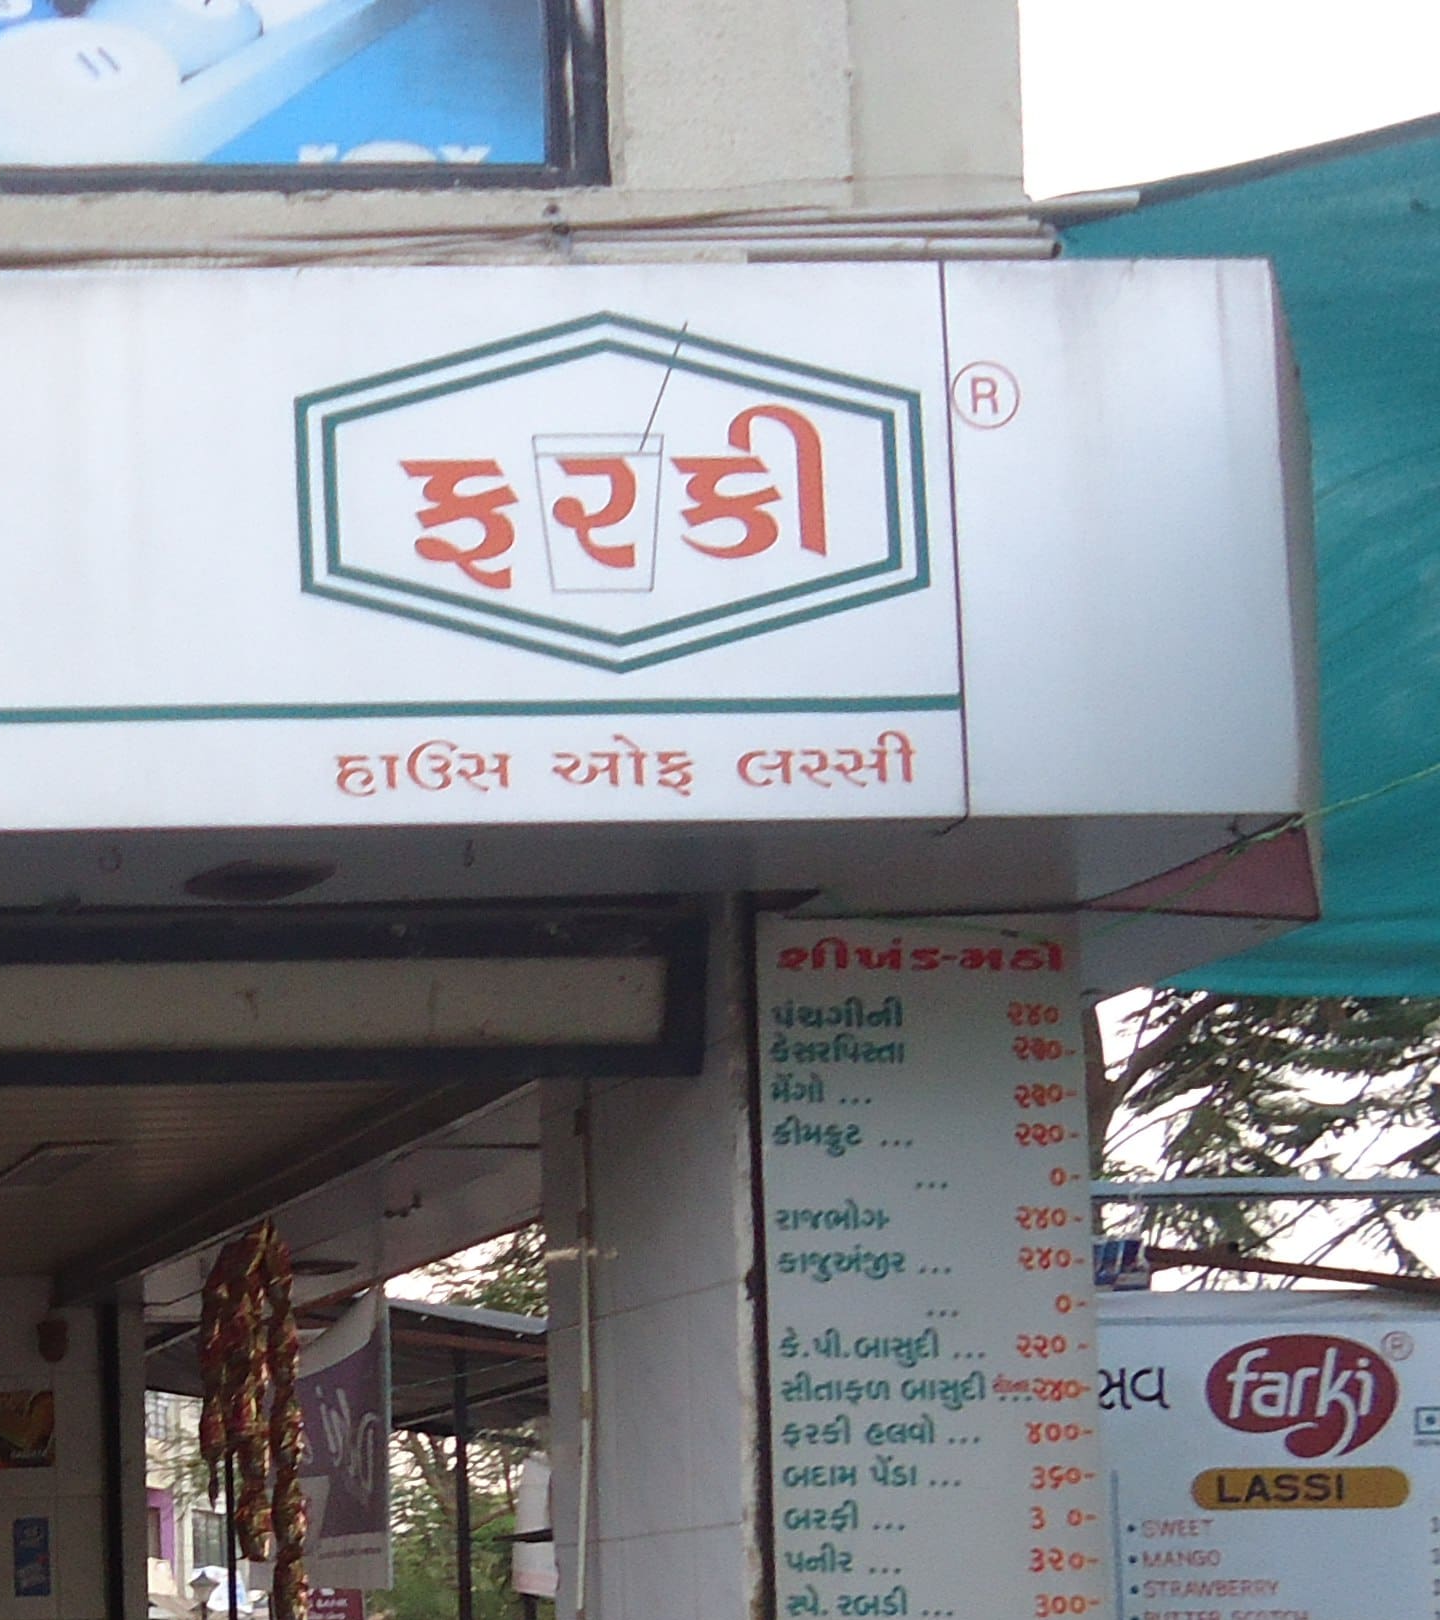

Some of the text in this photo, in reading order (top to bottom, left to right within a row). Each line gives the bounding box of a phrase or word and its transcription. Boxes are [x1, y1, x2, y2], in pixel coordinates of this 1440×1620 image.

[399, 404, 828, 590] ફરકી
[334, 729, 917, 797] હાઉસ ઓફ લસ્સી
[781, 1413, 851, 1446] ફરકી
[782, 1464, 857, 1489] બદામ
[1215, 1473, 1345, 1503] LASSI
[783, 1499, 859, 1532] બરફી
[1141, 1519, 1215, 1538] SWEET
[785, 1542, 854, 1574] પનીર
[1141, 1549, 1221, 1568] MANGO
[1142, 1579, 1280, 1599] STRAWBERRY
